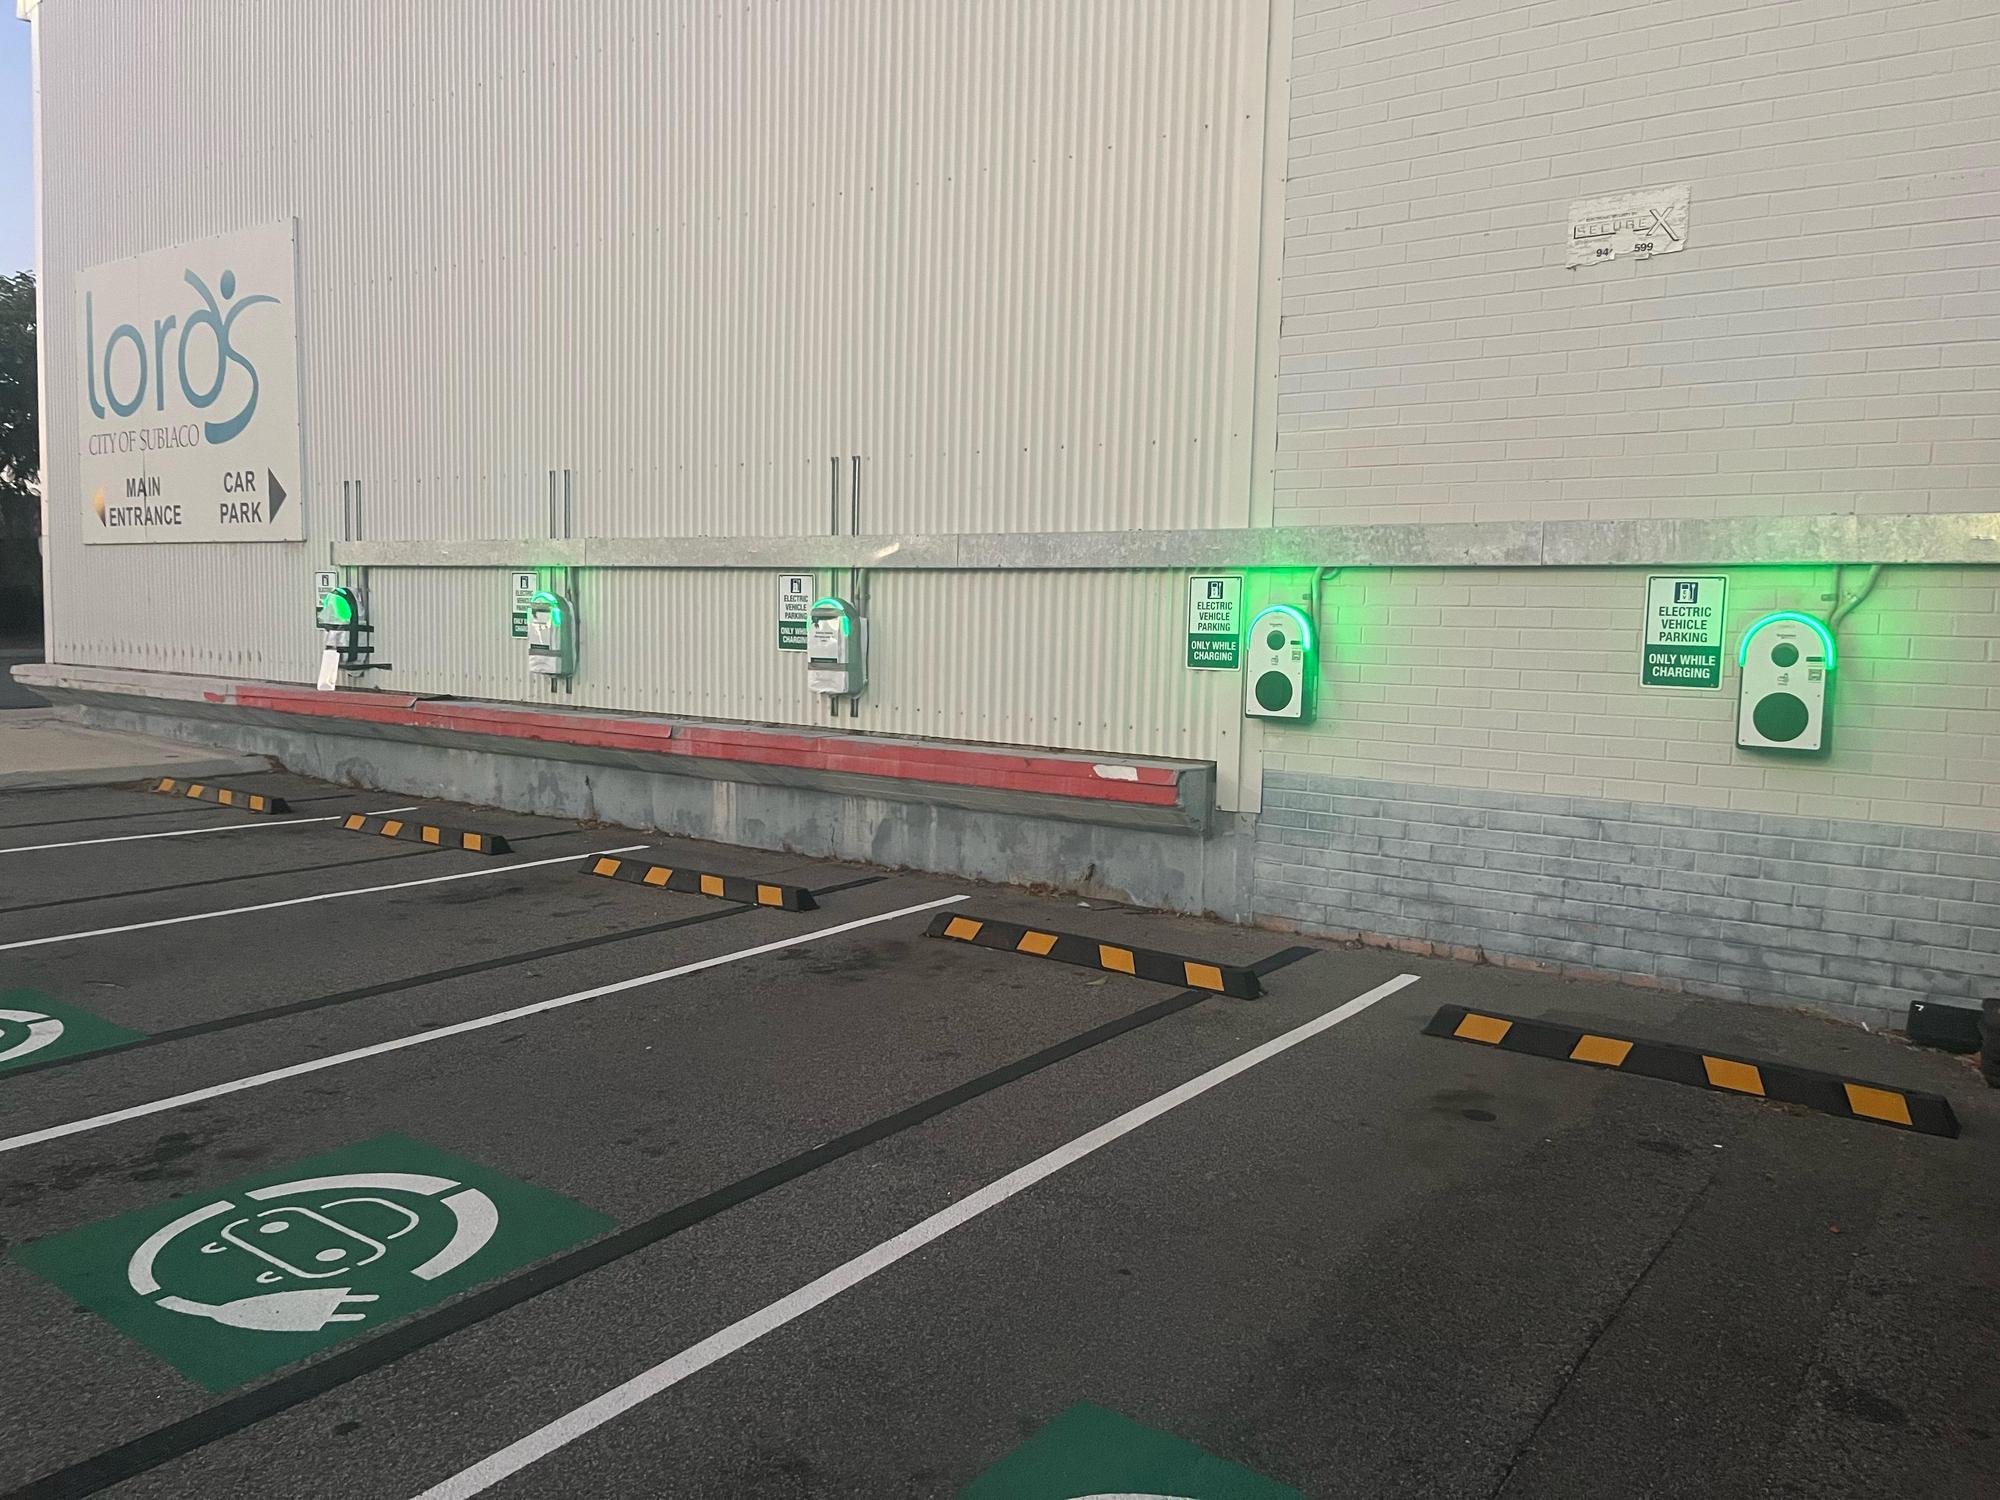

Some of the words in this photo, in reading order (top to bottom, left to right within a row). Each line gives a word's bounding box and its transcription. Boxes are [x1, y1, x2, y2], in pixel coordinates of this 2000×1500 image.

[1596, 248, 1613, 257] 94
[1634, 242, 1653, 252] 599
[86, 267, 281, 445] lords
[89, 432, 117, 455] CITY
[119, 430, 136, 453] OF
[139, 423, 200, 451] SUBIACO
[126, 477, 161, 497] MAIN
[223, 470, 256, 493] CAR
[109, 505, 182, 527] ENTRANCE
[220, 502, 262, 524] PARK
[785, 603, 807, 611] VEHICLE
[1197, 602, 1232, 610] ELECTRIC
[1659, 606, 1712, 617] ELECTRIC
[1199, 612, 1230, 620] VEHICLE
[1198, 623, 1231, 631] PARKING
[1661, 619, 1708, 630] VEHICLE
[781, 627, 794, 635] ONLY
[1659, 632, 1708, 643] PARKING
[1191, 640, 1210, 650] ONLY
[1212, 641, 1237, 651] WHILE
[1194, 652, 1232, 661] CHARGING
[1648, 653, 1677, 665] ONLY
[1680, 655, 1716, 666] WHILE
[1652, 666, 1710, 679] CHARGING
